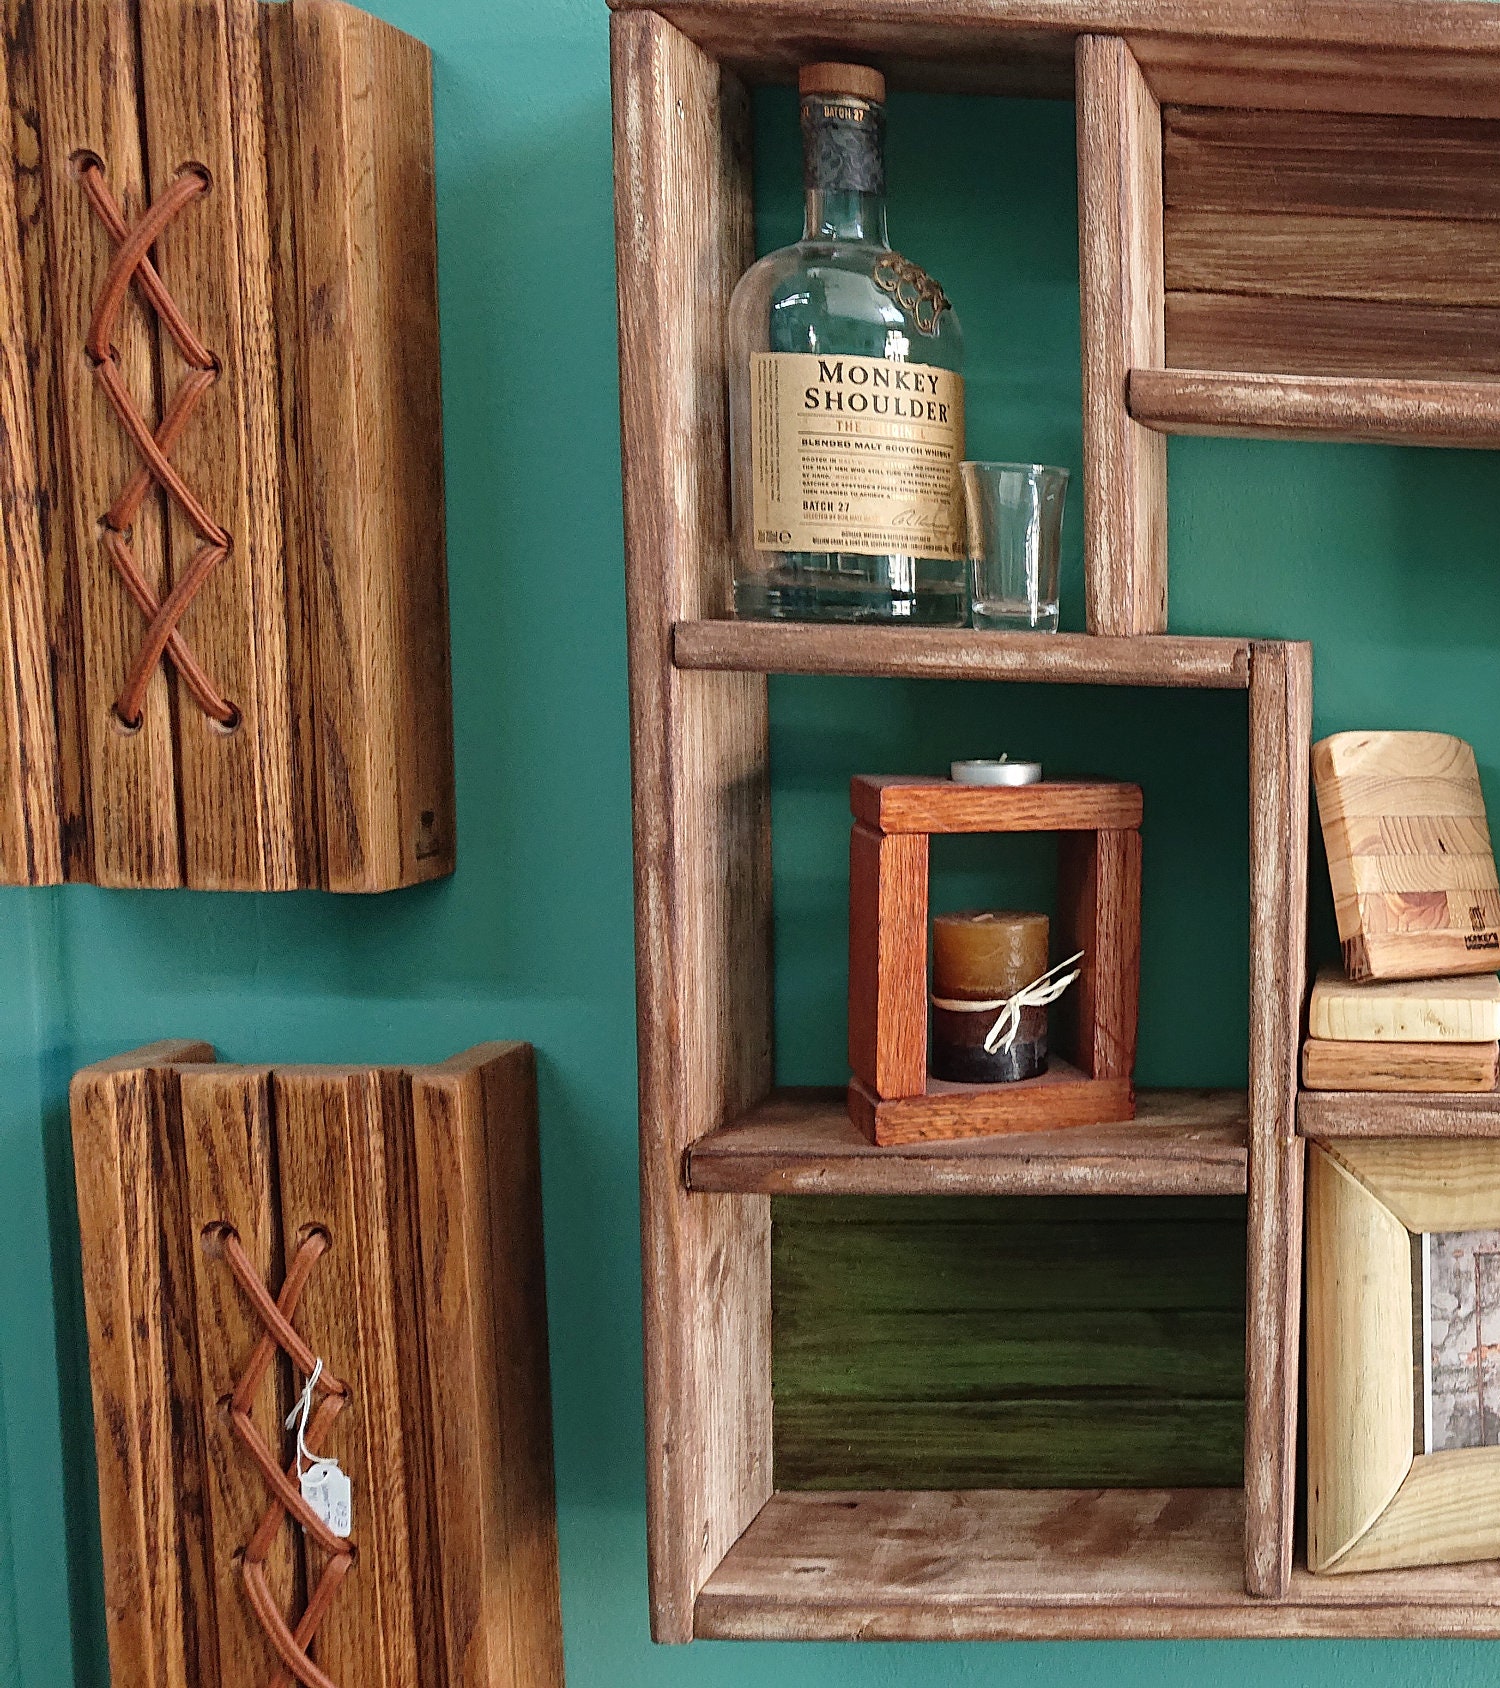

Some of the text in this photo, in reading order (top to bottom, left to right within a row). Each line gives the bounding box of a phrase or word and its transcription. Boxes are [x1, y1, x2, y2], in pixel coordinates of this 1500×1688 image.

[818, 360, 938, 395] MONKEY
[804, 388, 948, 423] SHOULDER
[836, 421, 861, 432] THE
[801, 439, 851, 448] BLENDED
[854, 441, 881, 451] MALT
[886, 445, 923, 456] SCOTCH
[802, 500, 850, 512] BATCH 27
